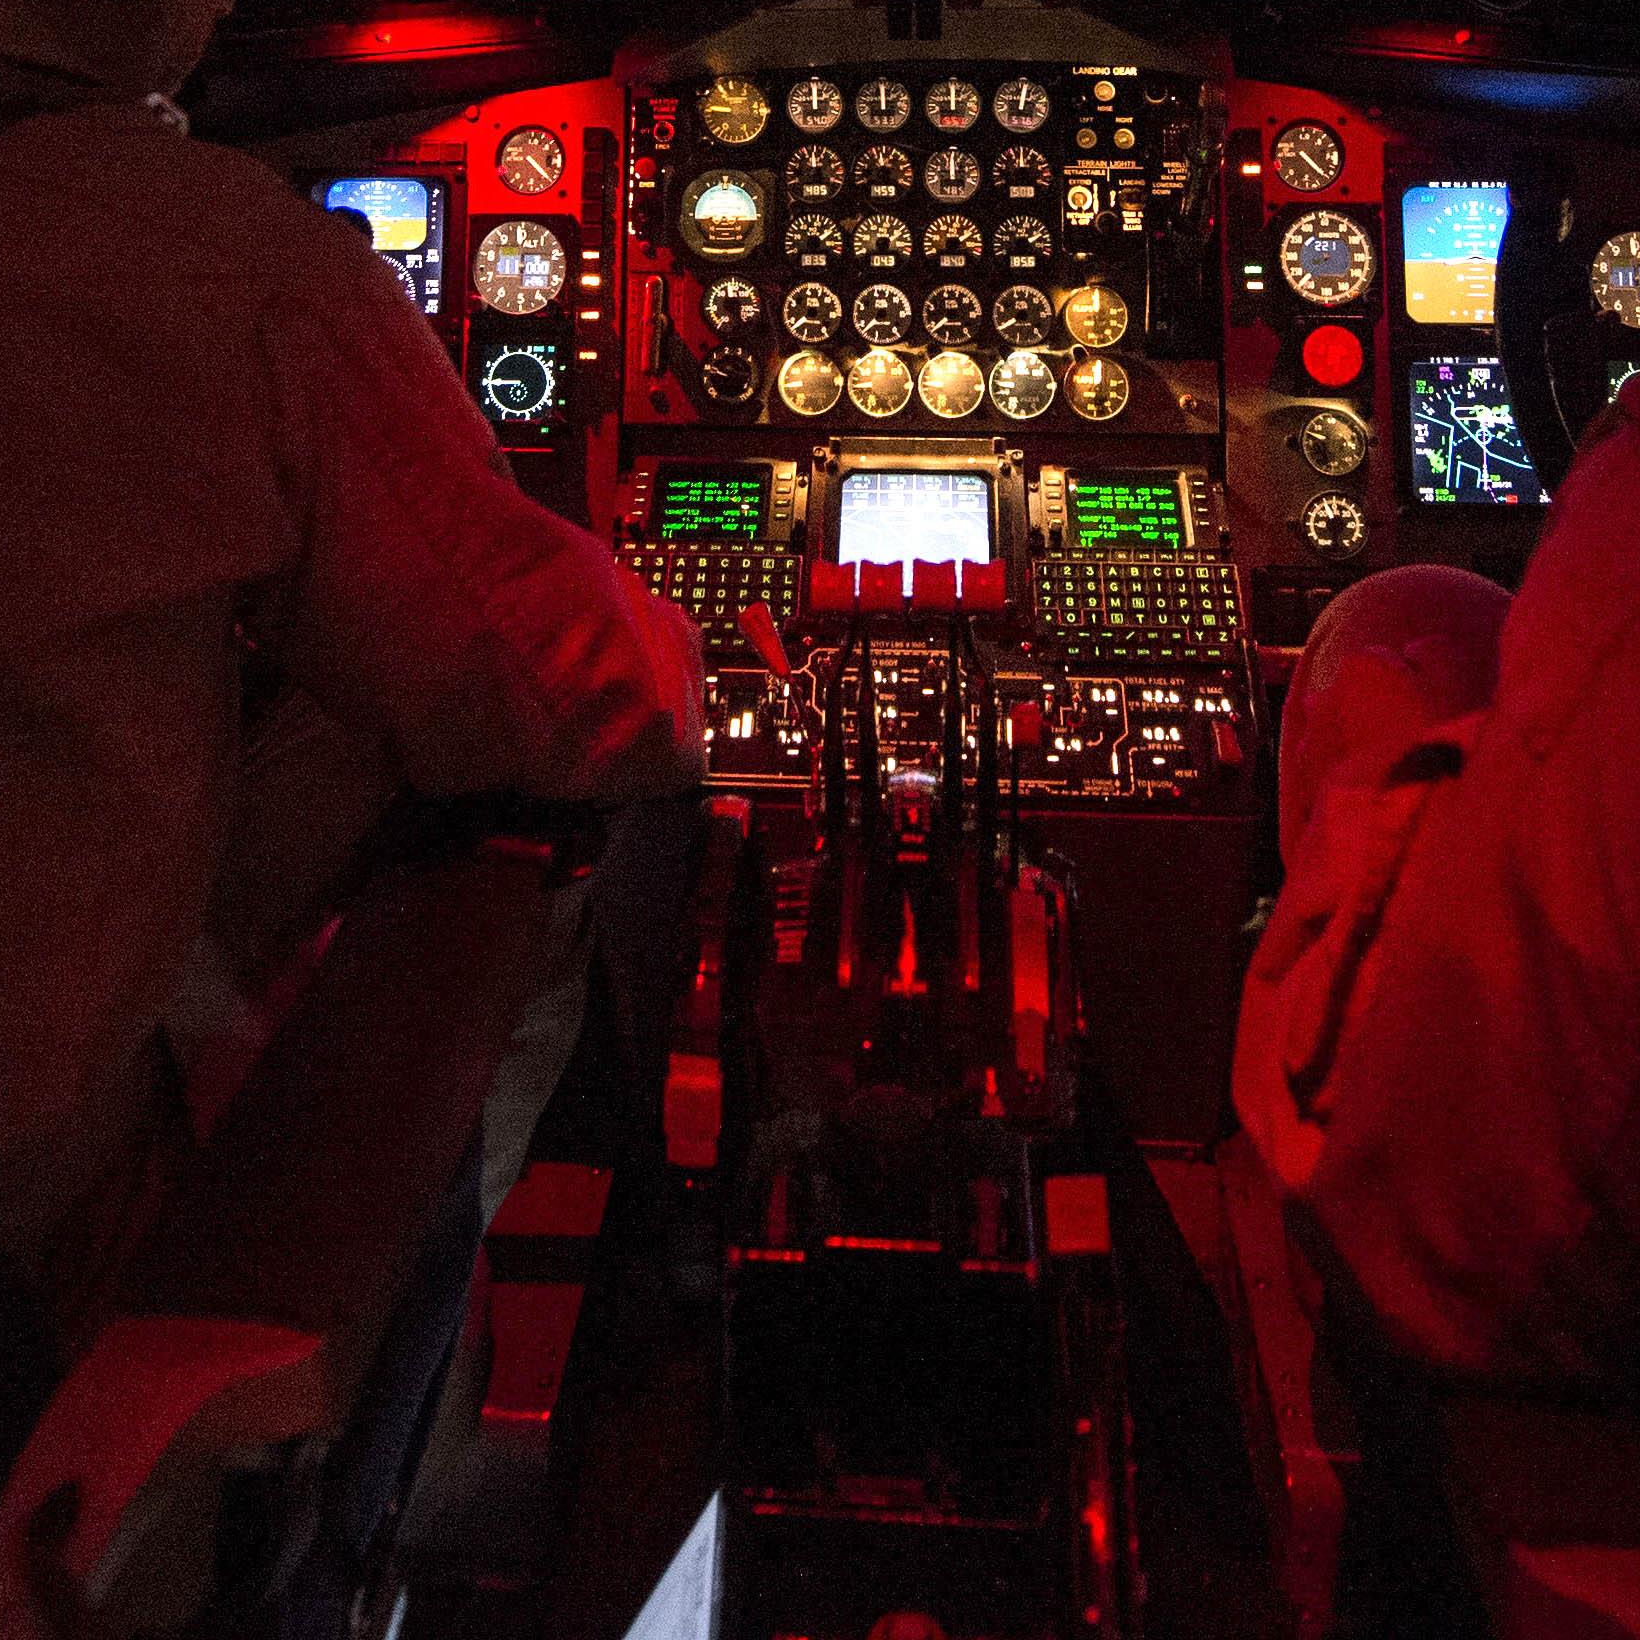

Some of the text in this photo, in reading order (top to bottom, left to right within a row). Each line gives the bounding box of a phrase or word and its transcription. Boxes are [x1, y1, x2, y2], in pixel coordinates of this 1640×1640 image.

[1073, 67, 1137, 75] LANDING GEAR
[523, 239, 538, 248] ALT
[1314, 241, 1336, 251] 221
[1612, 245, 1620, 256] 9
[1600, 262, 1608, 273] 8
[1601, 285, 1608, 295] 7
[1614, 300, 1622, 311] 6
[1064, 567, 1071, 575] 2
[1086, 567, 1094, 576] 3
[1109, 567, 1117, 576] A
[1131, 567, 1139, 576] B
[1153, 568, 1161, 576] C
[1176, 568, 1184, 576] D
[1221, 569, 1228, 578] F
[1042, 582, 1051, 590] 4
[1065, 582, 1073, 591] 5
[1087, 582, 1095, 591] 6
[1110, 583, 1118, 592] G
[1132, 583, 1141, 592] H
[1179, 584, 1186, 592] J
[1201, 584, 1209, 593] K
[1224, 585, 1232, 594] L
[1044, 597, 1051, 606] 7
[1066, 597, 1074, 606] 8
[1088, 598, 1097, 606] 9
[1111, 598, 1121, 607] M
[1180, 599, 1188, 608] P
[1202, 599, 1211, 609] Q
[1226, 600, 1234, 609] R
[1136, 614, 1144, 624] T
[1159, 615, 1167, 624] U
[1181, 615, 1190, 624] V
[1228, 616, 1237, 625] X
[1195, 632, 1204, 641] Y
[1219, 632, 1228, 641] Z
